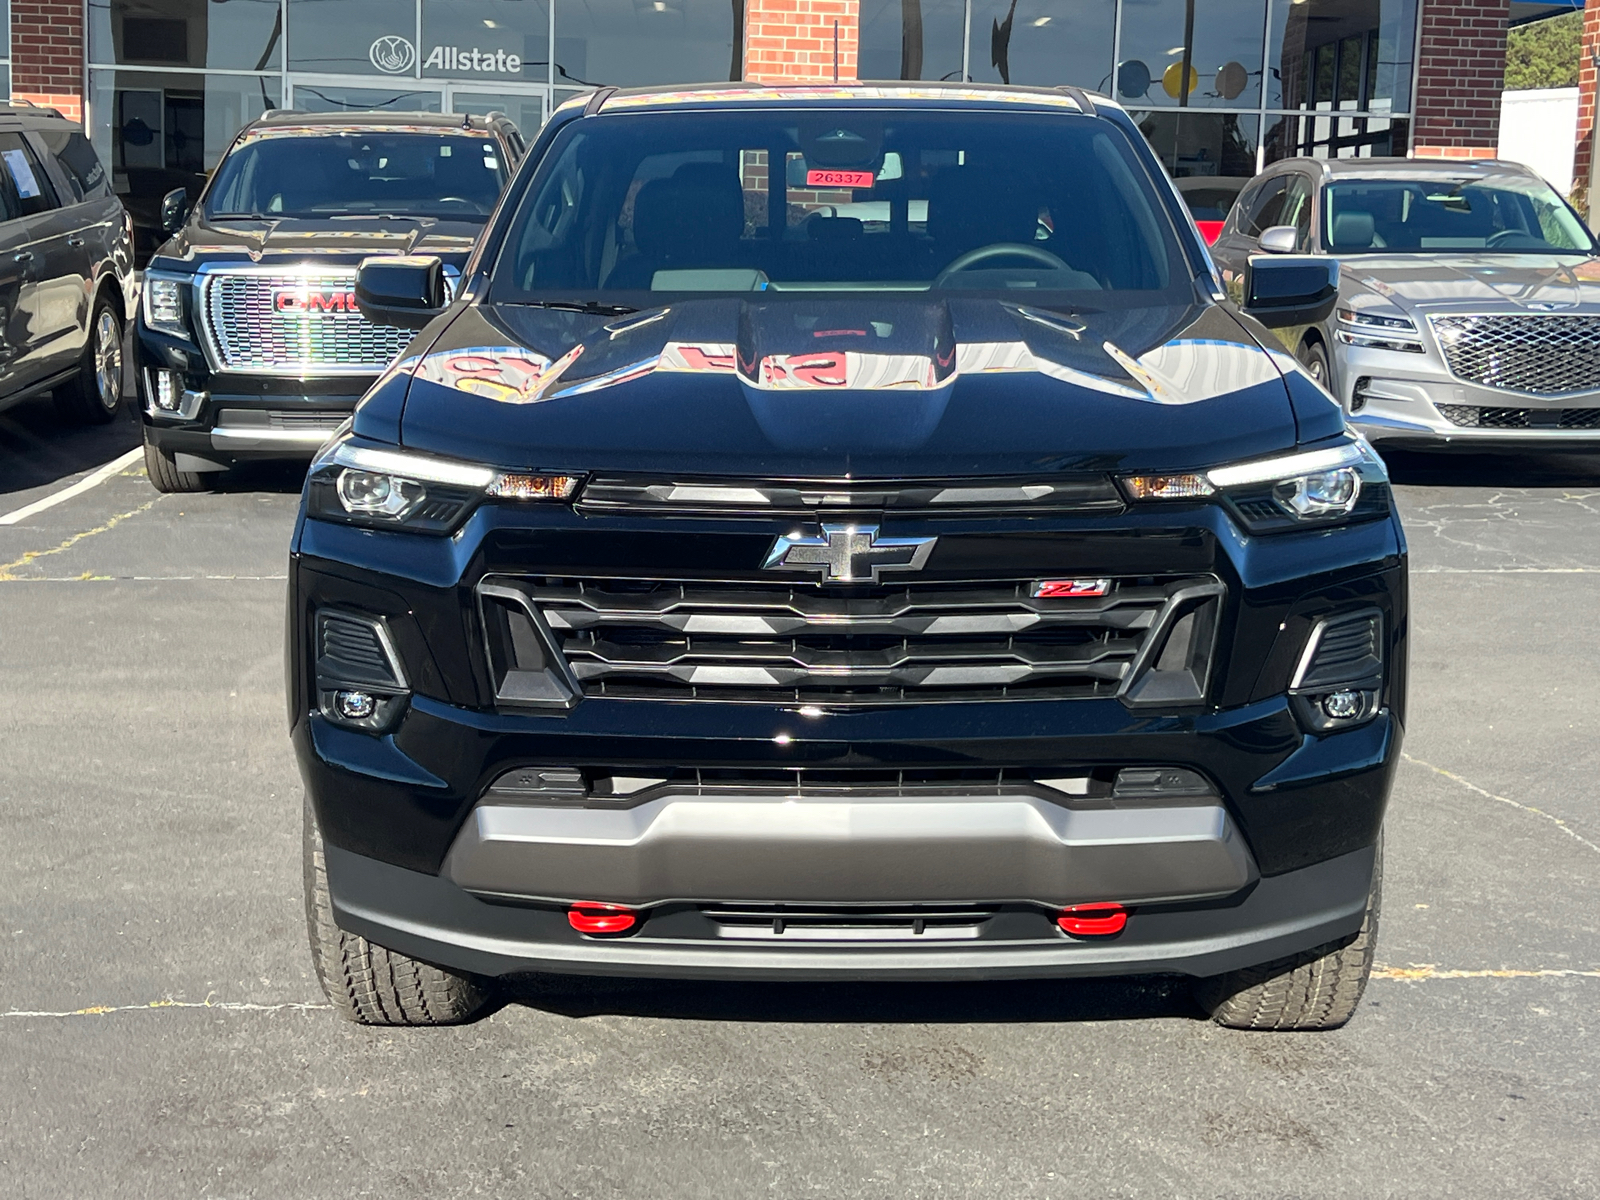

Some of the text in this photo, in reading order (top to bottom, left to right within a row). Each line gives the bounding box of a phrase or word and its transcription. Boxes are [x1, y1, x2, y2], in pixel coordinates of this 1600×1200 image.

[423, 46, 521, 73] Allstate
[815, 172, 863, 184] 26337
[1034, 579, 1107, 598] Z71
